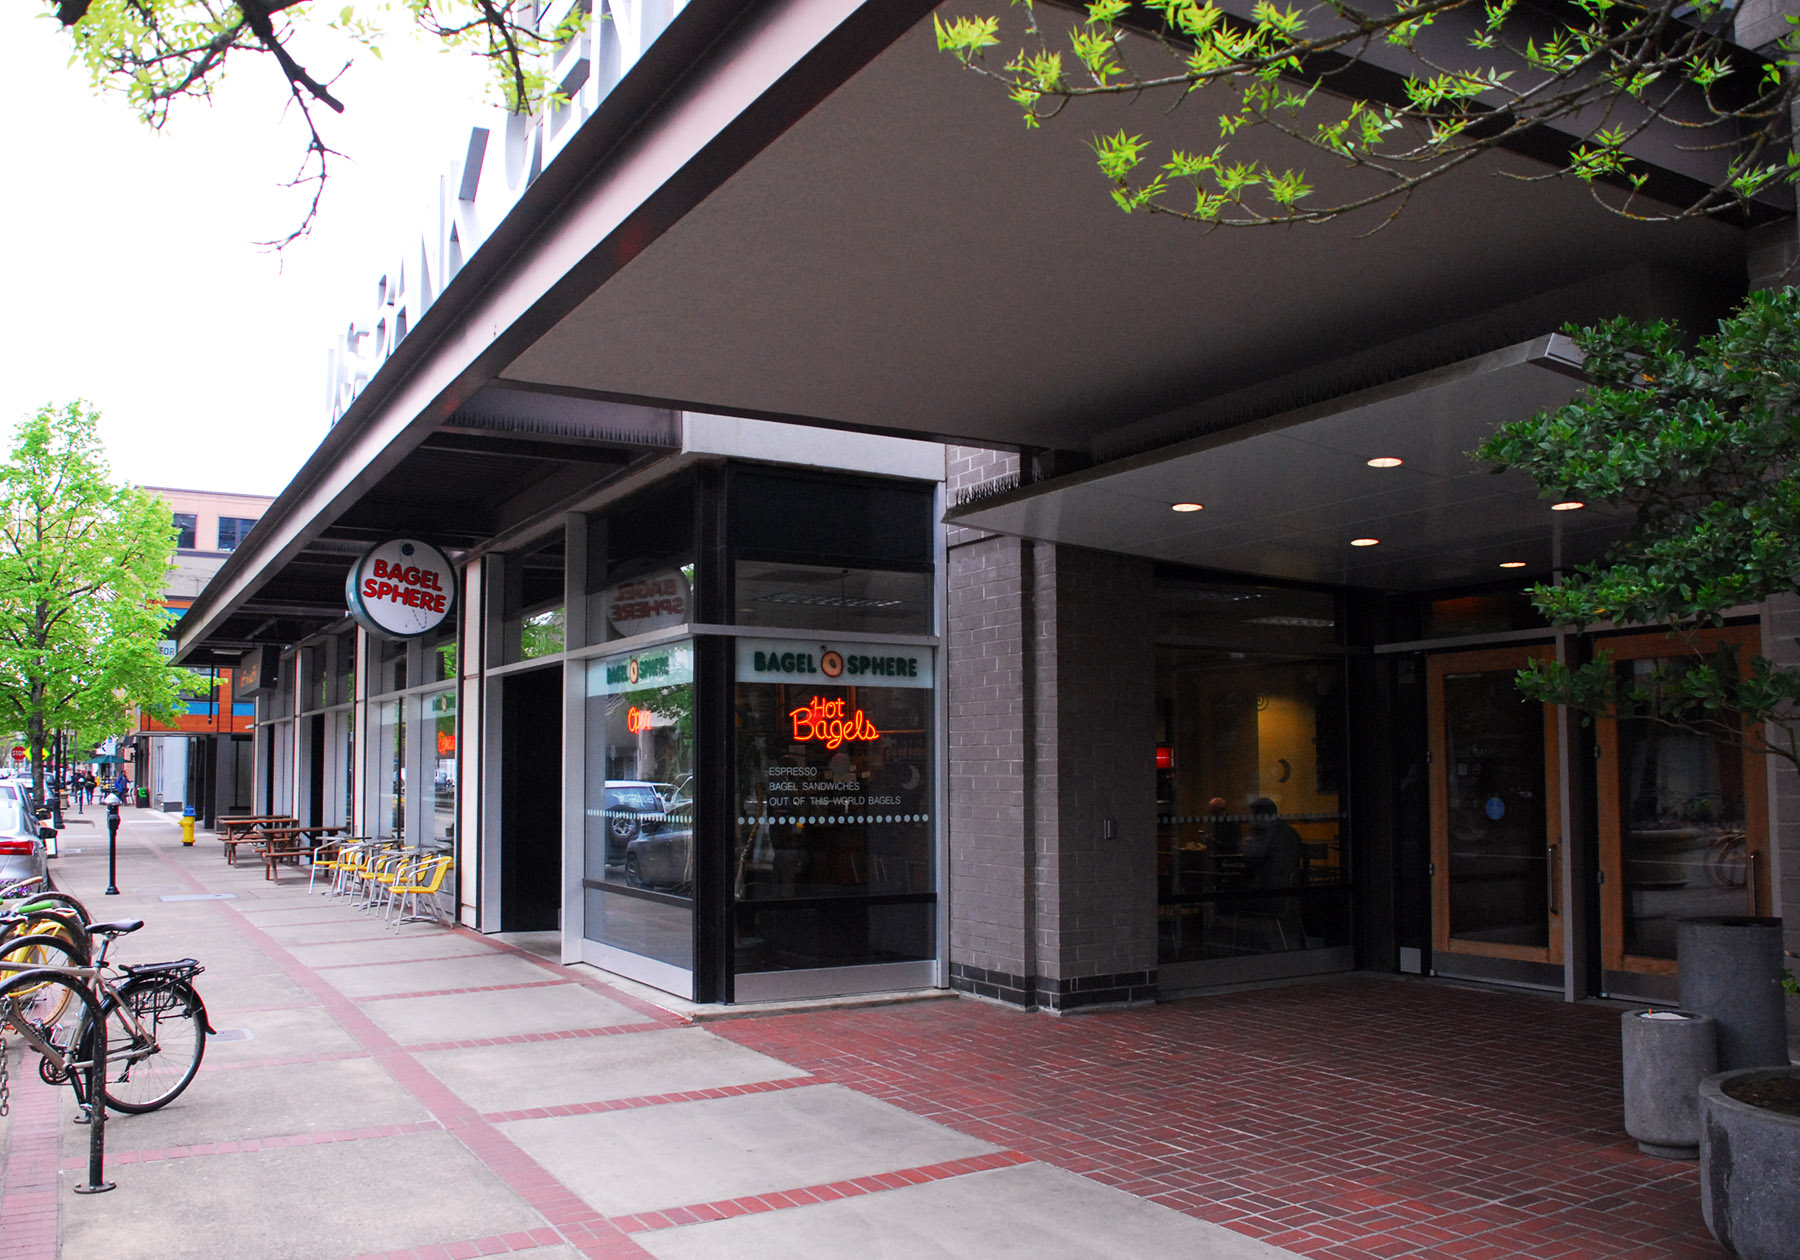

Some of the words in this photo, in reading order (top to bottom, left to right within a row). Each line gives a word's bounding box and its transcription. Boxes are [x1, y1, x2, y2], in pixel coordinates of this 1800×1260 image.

[373, 559, 443, 592] BAGEL
[363, 578, 447, 614] SPHERE
[754, 651, 817, 673] BAGEL
[847, 655, 918, 677] SPHERE
[810, 695, 846, 719] Hot
[627, 706, 653, 735] Open
[788, 707, 880, 750] Bagels
[768, 766, 817, 776] ESPRESSO
[768, 782, 798, 791] BAGEL
[802, 781, 860, 791] SANDWICHES
[769, 797, 789, 806] OUT
[792, 796, 805, 806] OF
[809, 796, 829, 806] THIS
[832, 796, 865, 806] WORLD
[868, 795, 901, 805] BAGELS
